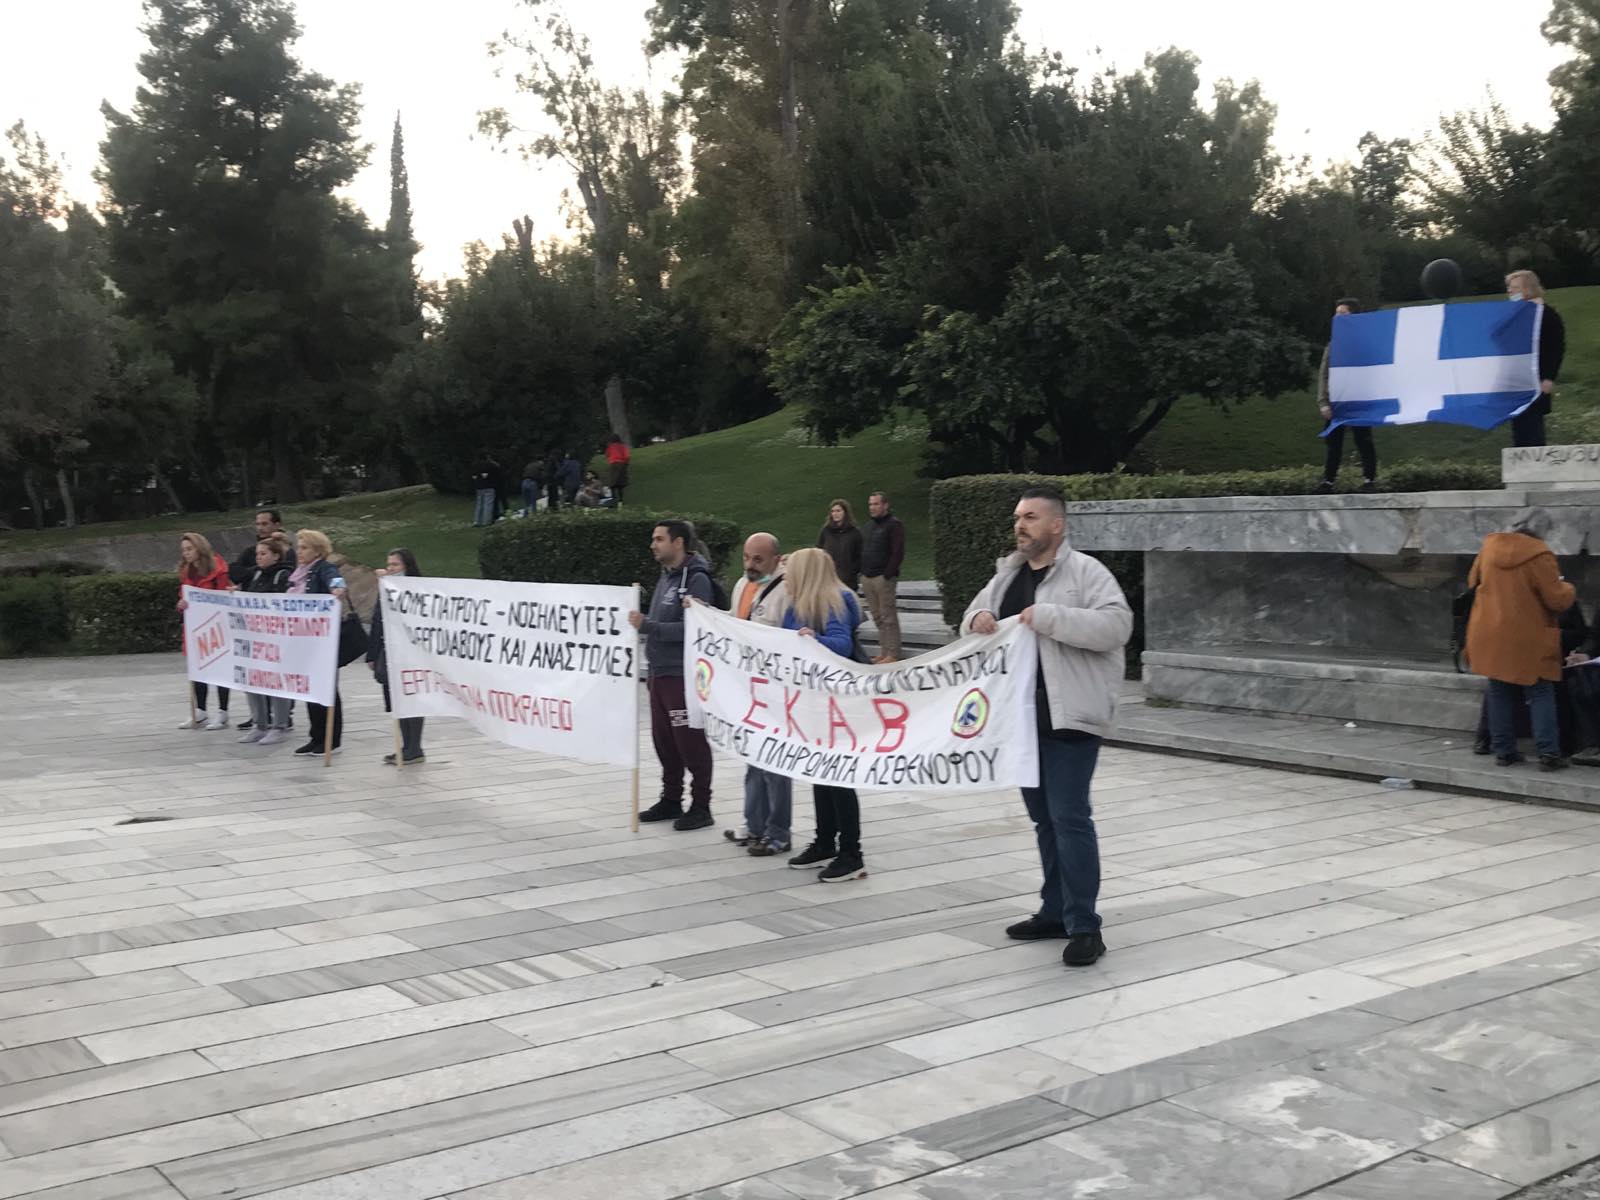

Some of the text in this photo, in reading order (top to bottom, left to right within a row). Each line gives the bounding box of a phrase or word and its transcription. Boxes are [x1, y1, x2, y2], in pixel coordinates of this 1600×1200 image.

[508, 601, 621, 636] ΝΟΣΗΛΕΥΤΕΣ
[197, 621, 225, 660] ΝΑΙ
[500, 636, 526, 667] ΚΑΙ
[529, 641, 634, 678] ΑΝΑΣΤΟΛΕΣ
[756, 736, 859, 782] ΠΛΗΡΩΜΑΤΑ
